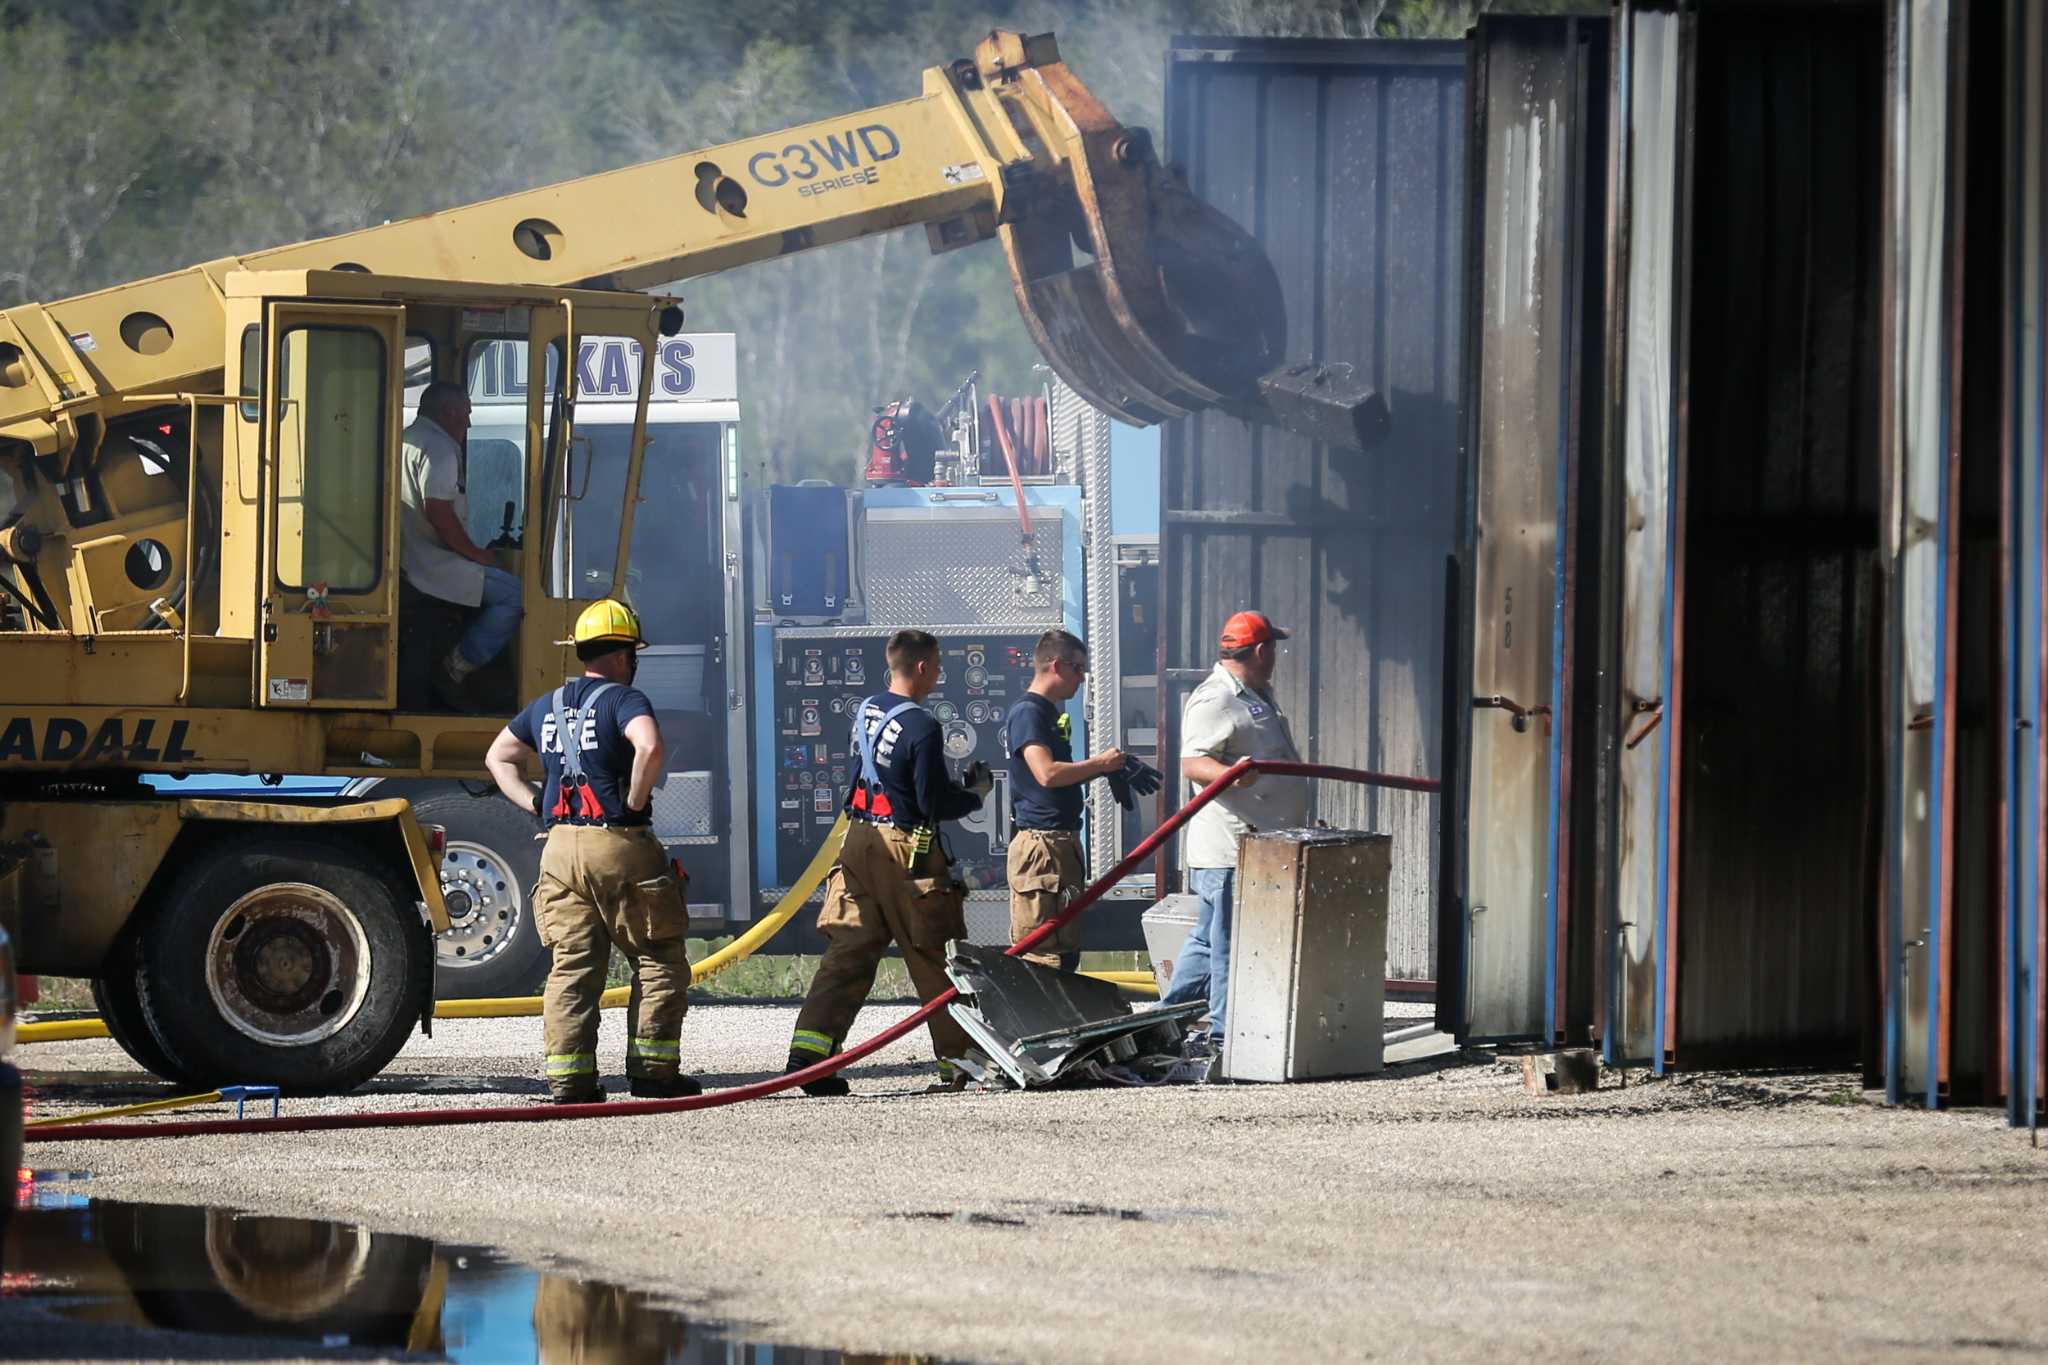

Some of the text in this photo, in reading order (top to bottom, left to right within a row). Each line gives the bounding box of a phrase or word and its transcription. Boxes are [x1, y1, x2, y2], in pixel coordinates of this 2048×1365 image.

[748, 124, 901, 188] G3WD
[798, 172, 868, 198] SERIES
[469, 341, 696, 396] ILKATS
[0, 717, 197, 762] ADALL
[541, 719, 599, 753] FIE
